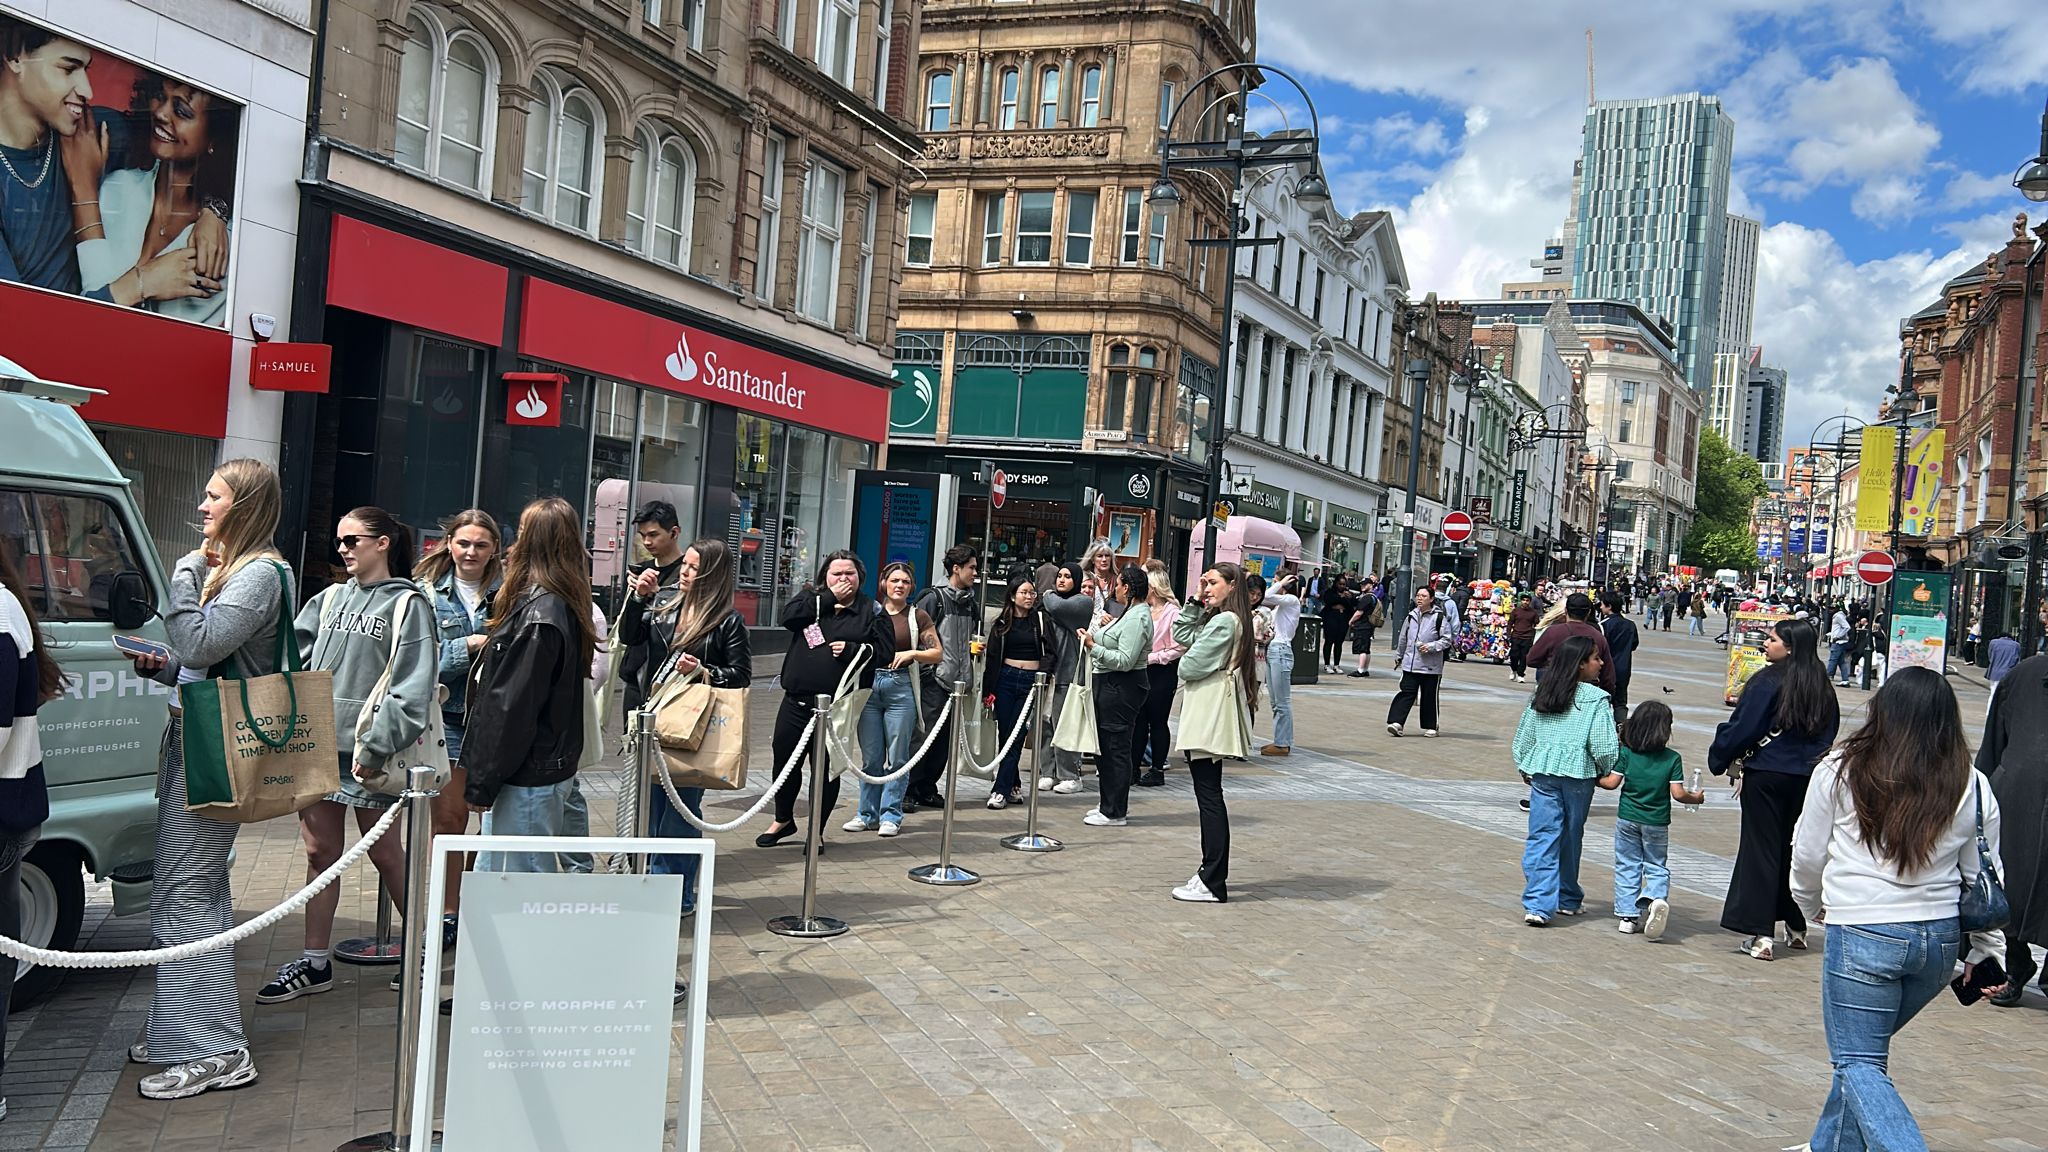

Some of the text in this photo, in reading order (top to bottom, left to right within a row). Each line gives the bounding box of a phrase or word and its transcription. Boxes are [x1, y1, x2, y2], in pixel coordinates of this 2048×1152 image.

[702, 351, 806, 410] Santander
[1004, 474, 1020, 482] DY
[1265, 493, 1280, 510] BANK
[1512, 474, 1524, 526] QUEENS ARCADE
[54, 669, 169, 700] RPHE
[276, 714, 308, 725] THIGS
[236, 728, 312, 744] HAPEN ERY
[238, 746, 265, 759] TIME
[288, 742, 316, 753] SHOP
[522, 902, 620, 914] MORPHE
[480, 1000, 647, 1011] SHOP MORPHE AT
[472, 1024, 652, 1034] BOOTS TRINITY CENTRE
[484, 1048, 636, 1058] BOOTS WHITE ROSE
[488, 1060, 632, 1070] SHOPPING CENTRE
